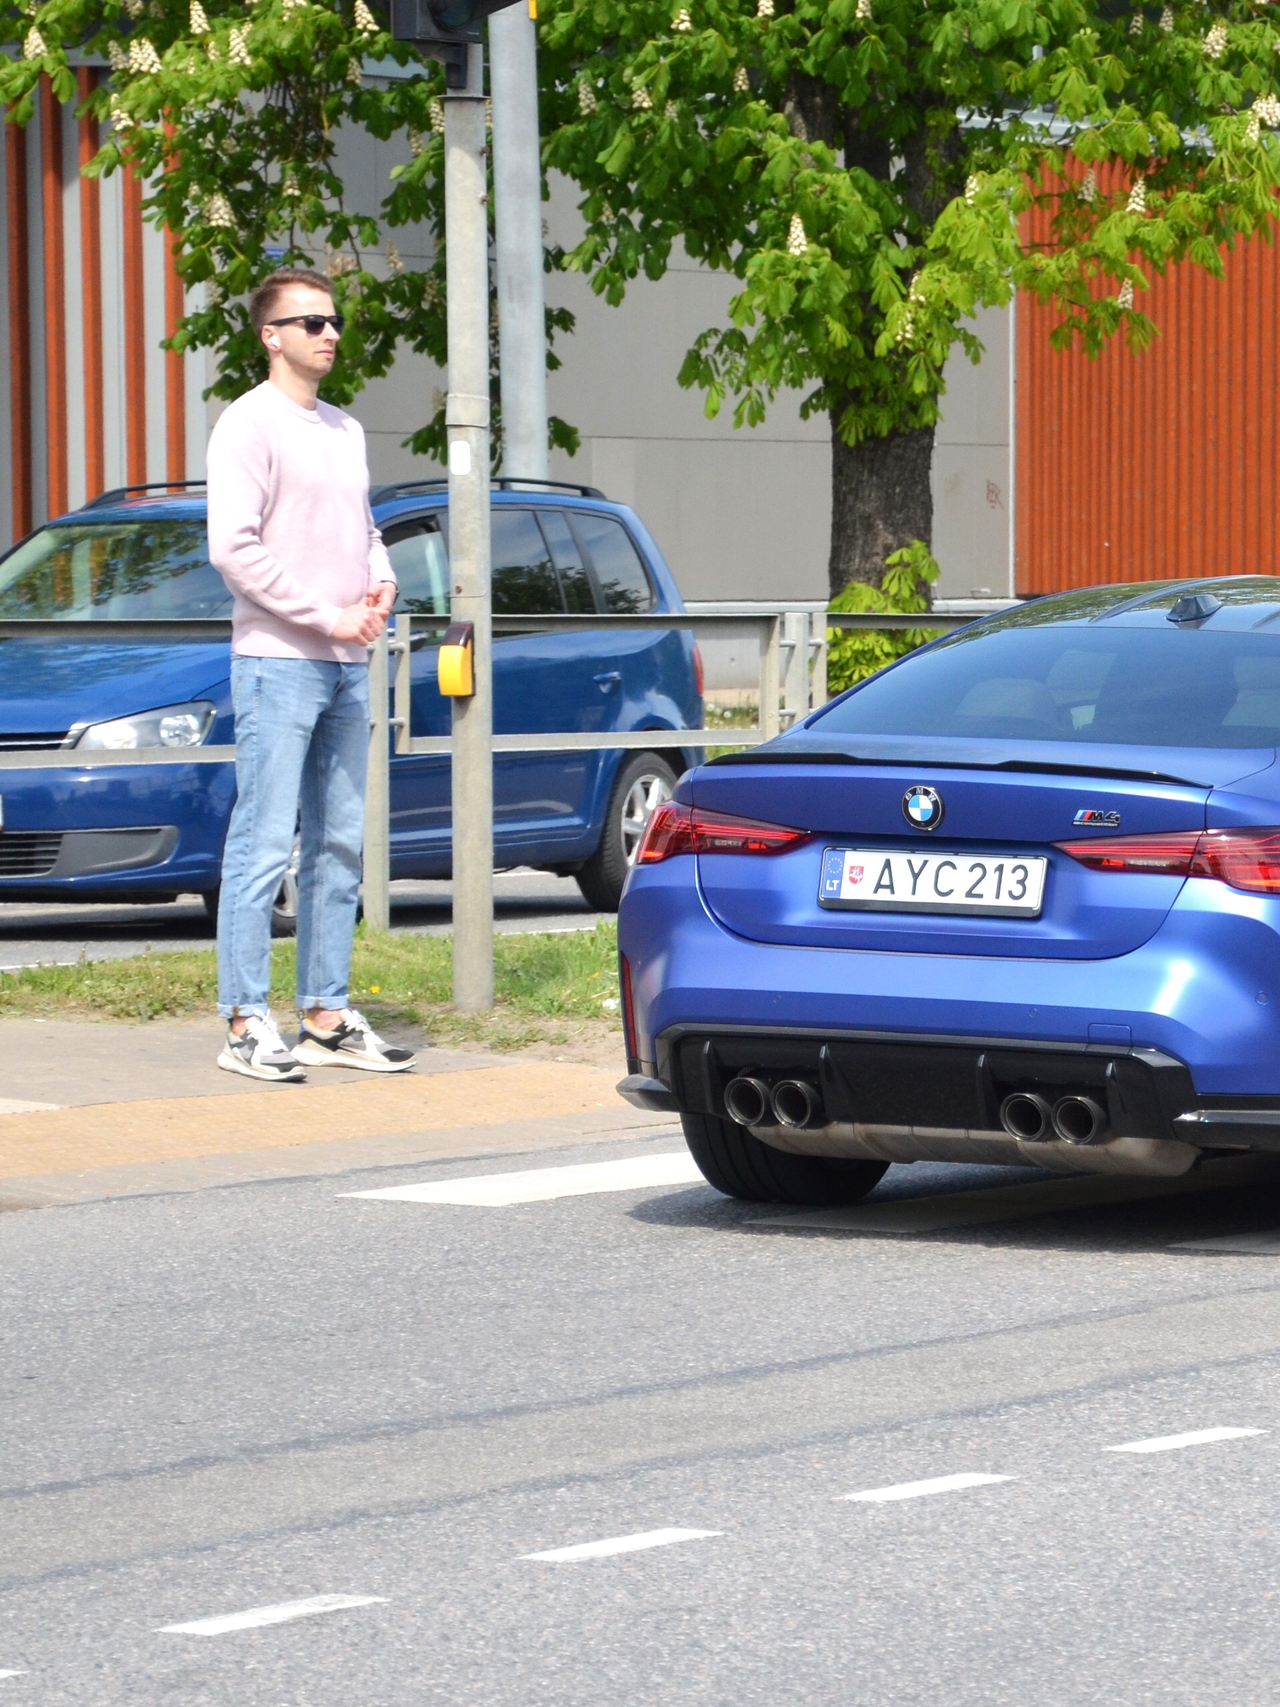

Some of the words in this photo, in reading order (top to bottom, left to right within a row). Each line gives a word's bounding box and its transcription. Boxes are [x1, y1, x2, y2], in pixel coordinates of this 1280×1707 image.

[905, 786, 937, 802] BMW
[1087, 810, 1120, 823] M4
[826, 879, 838, 892] LT
